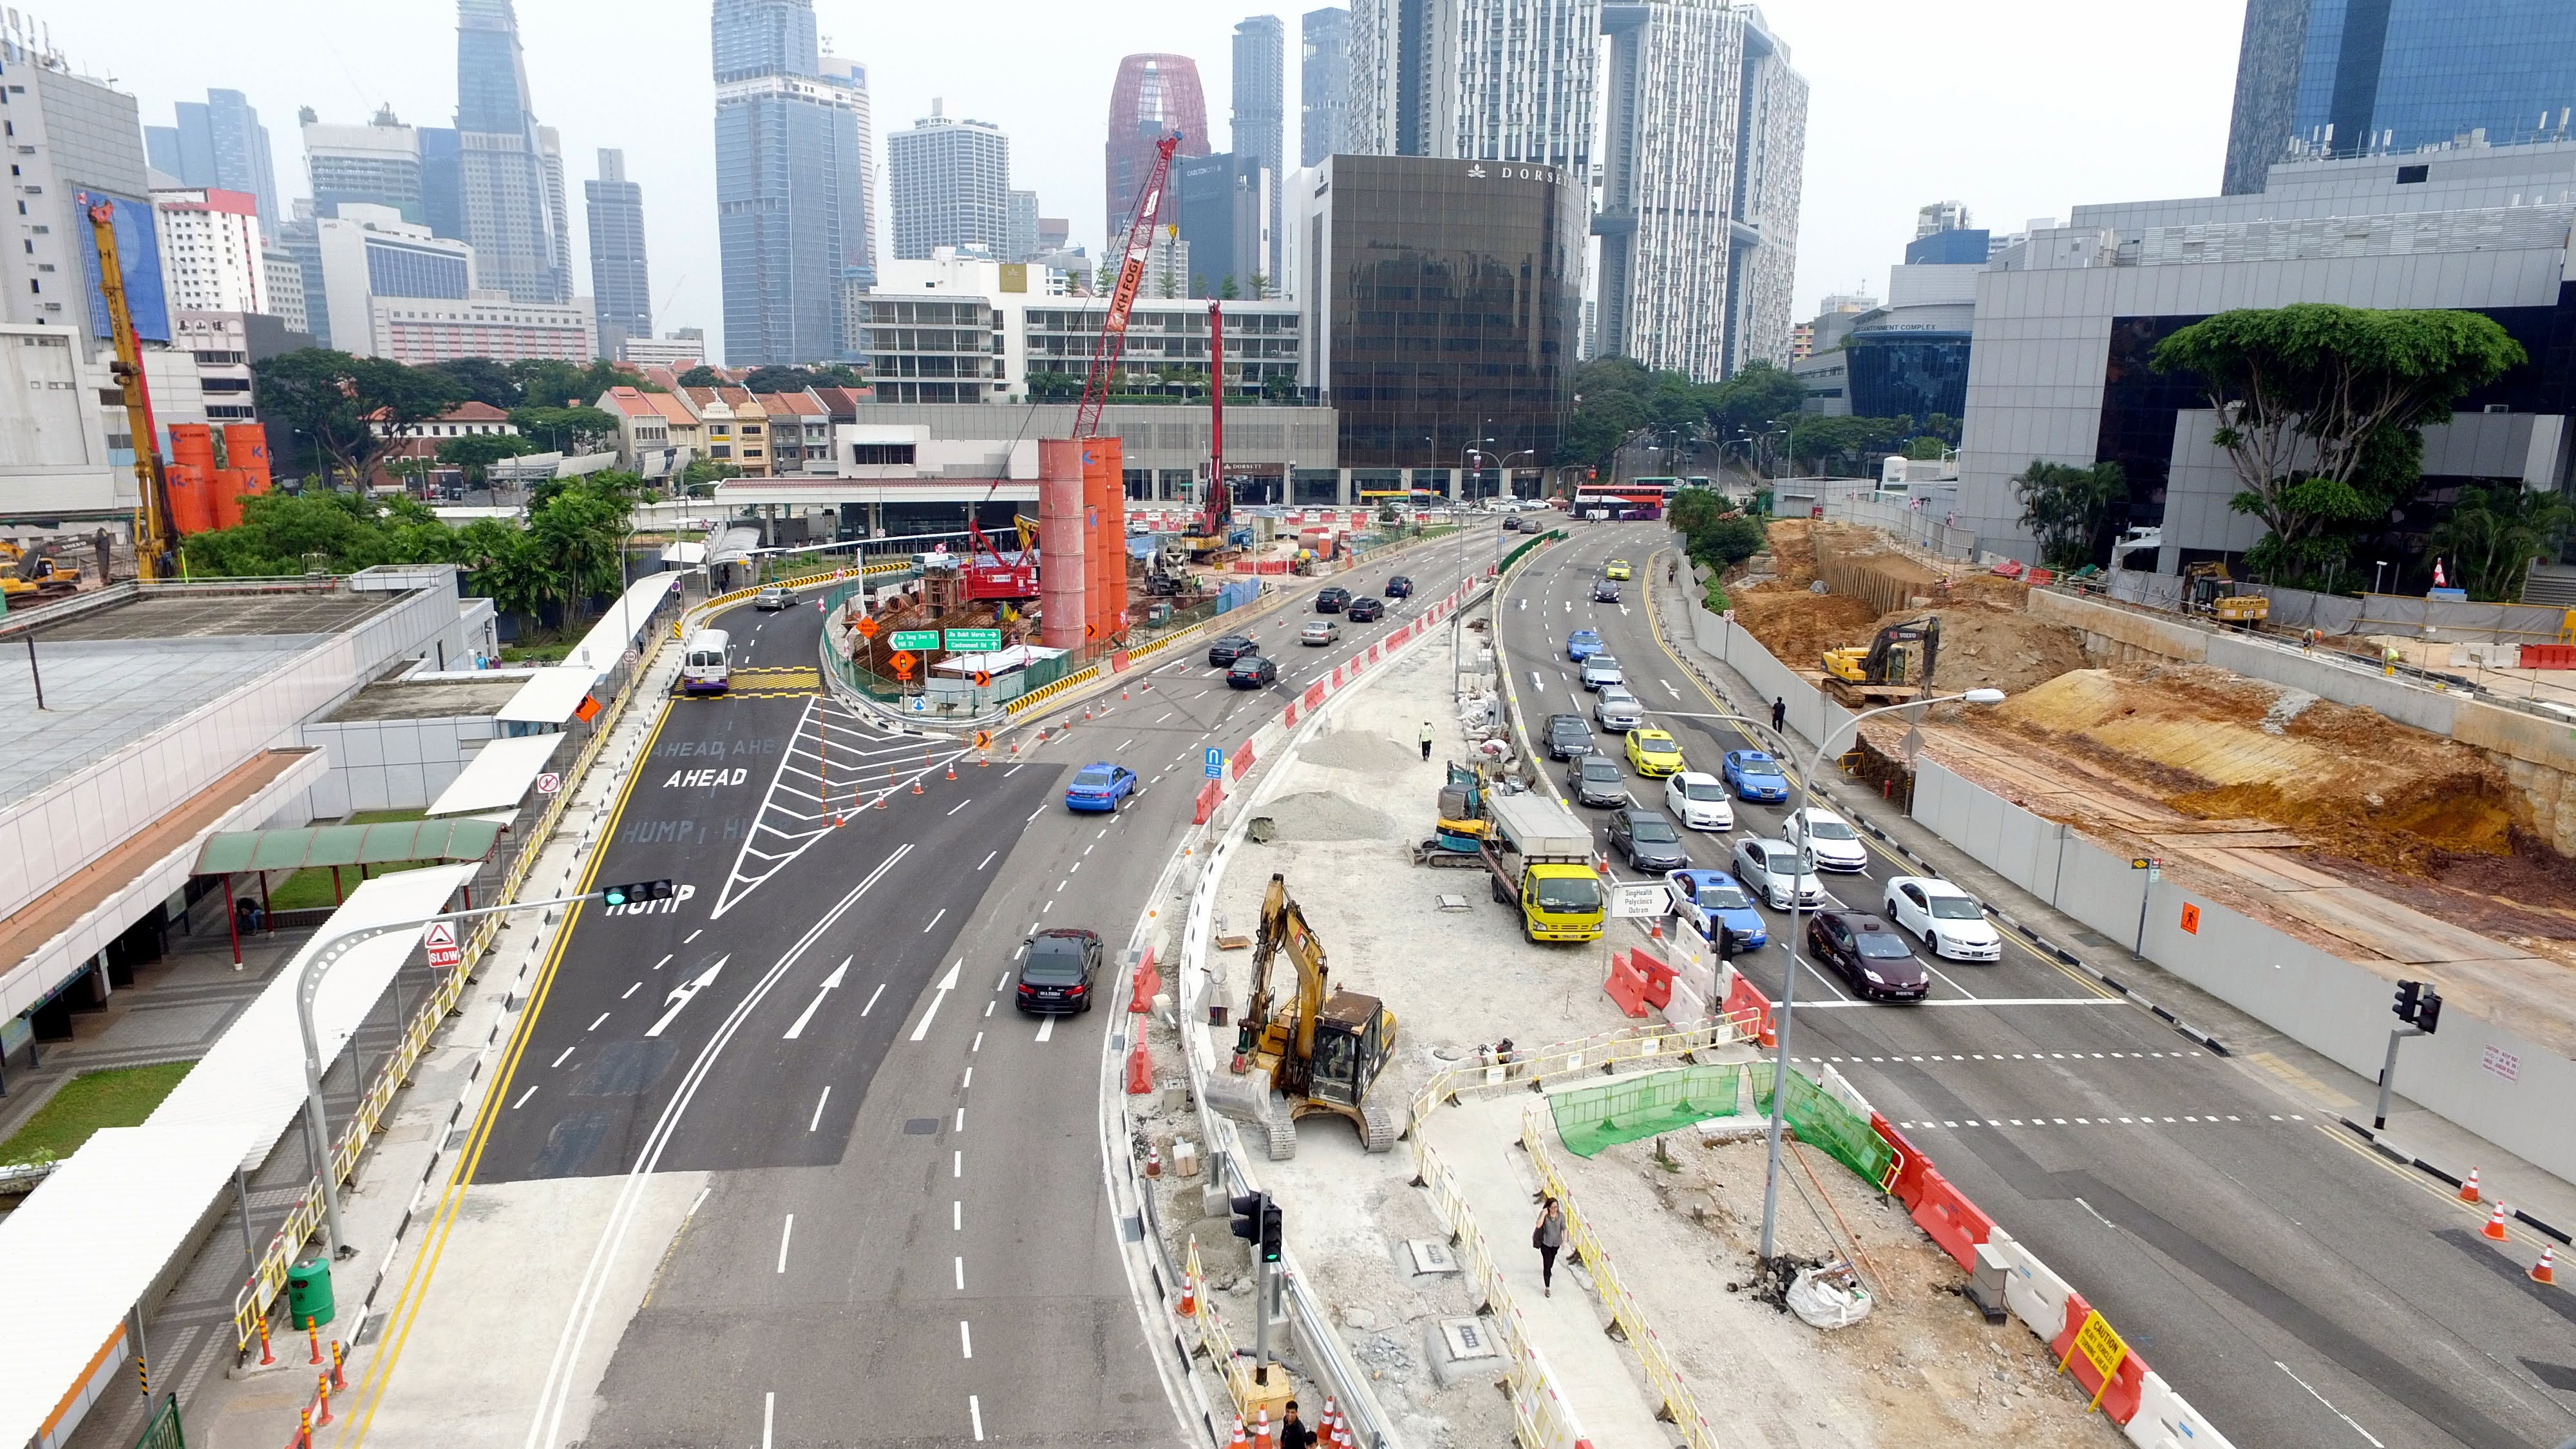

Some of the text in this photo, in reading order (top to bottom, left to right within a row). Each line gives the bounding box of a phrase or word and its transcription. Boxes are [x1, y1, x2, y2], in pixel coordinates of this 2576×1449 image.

[1187, 167, 1207, 177] CARLTON
[1116, 293, 1128, 313] KH
[61, 541, 87, 549] VOLVO
[663, 768, 748, 788] AHEAD
[621, 820, 694, 844] HUMP
[1625, 889, 1653, 897] SingHealth
[430, 951, 457, 963] SLOW
[2084, 1327, 2114, 1365] HEAVY VEHICLES
[2093, 1321, 2119, 1354] CAUTION
[2079, 1336, 2108, 1372] TURNING AHEAD
